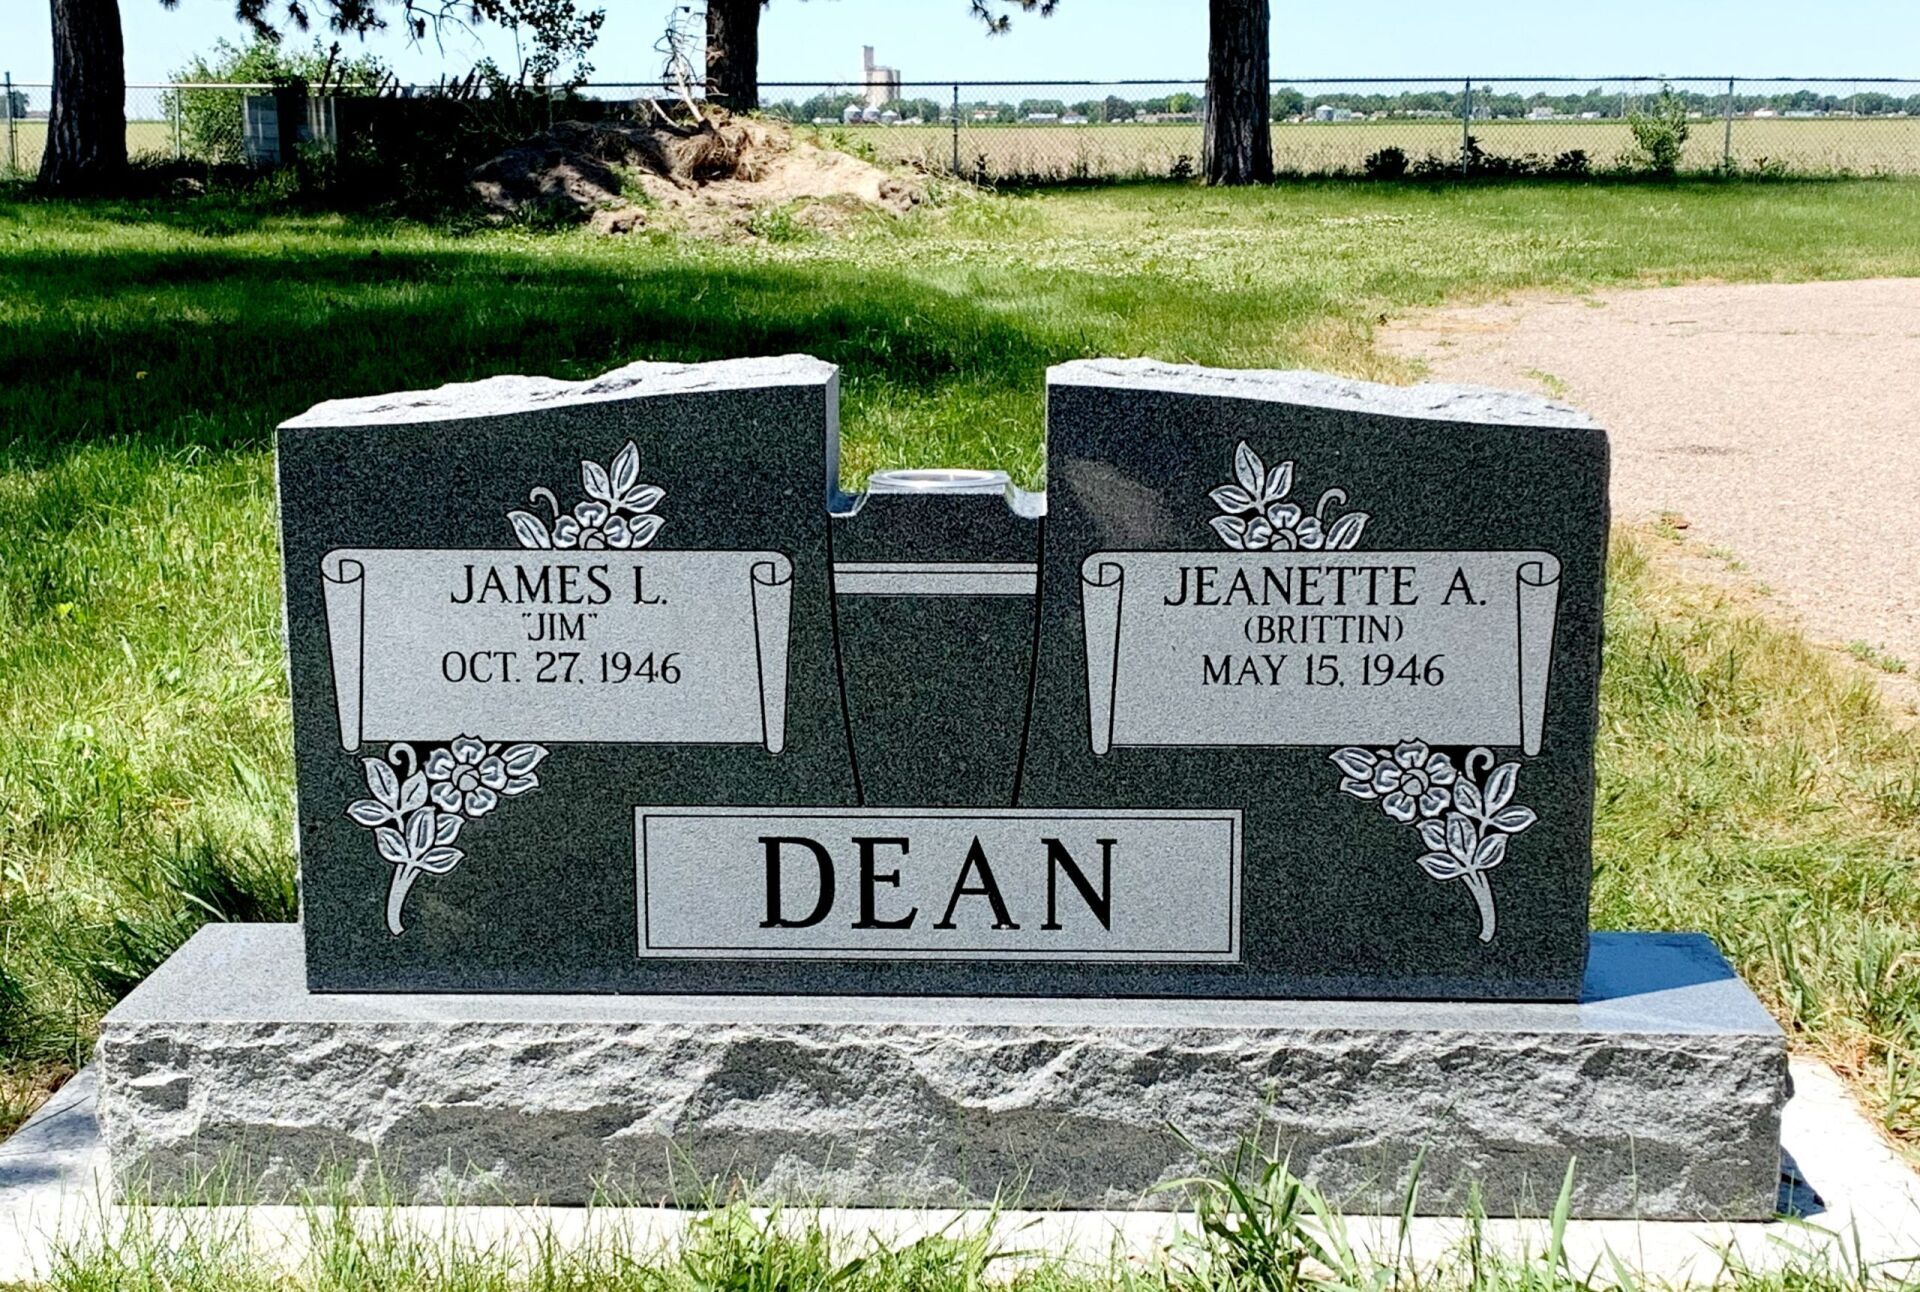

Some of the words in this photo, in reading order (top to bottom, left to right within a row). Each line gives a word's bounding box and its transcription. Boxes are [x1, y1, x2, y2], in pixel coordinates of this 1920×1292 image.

[450, 564, 612, 604] JAMES
[632, 565, 668, 605] L.
[1163, 565, 1419, 606] JEANETTE
[1440, 566, 1487, 606] A.
[521, 612, 598, 642] "JIM"
[1244, 614, 1404, 644] (BRITTIN)
[441, 650, 521, 683] OCT.
[536, 651, 584, 684] 27,
[600, 651, 681, 684] 1946
[1202, 654, 1288, 686] MAY
[1305, 653, 1345, 687] 15,
[1361, 653, 1445, 687] 1946
[757, 835, 1118, 932] DEAN
